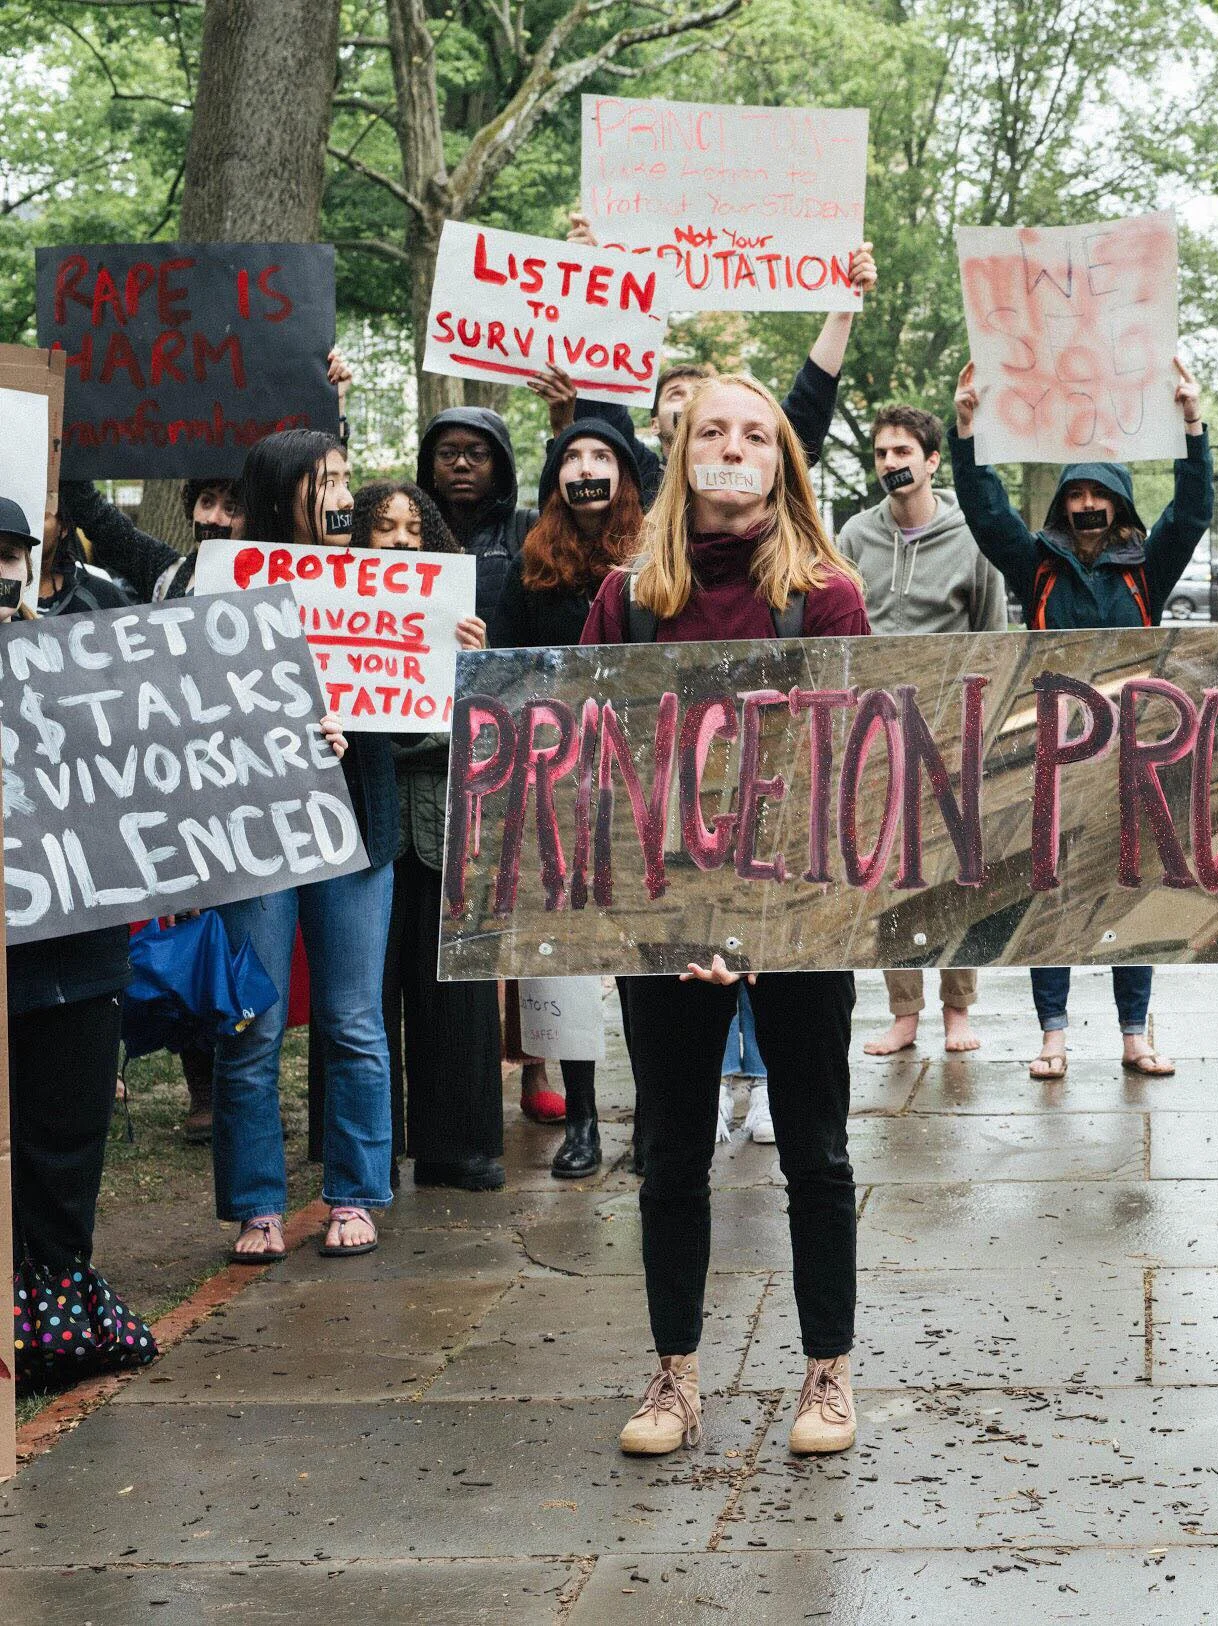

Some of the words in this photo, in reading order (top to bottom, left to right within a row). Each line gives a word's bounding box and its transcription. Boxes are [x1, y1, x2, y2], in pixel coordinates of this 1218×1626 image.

[474, 233, 656, 313] LISTEN
[722, 228, 774, 248] Your
[54, 254, 197, 328] RAPE
[237, 265, 294, 323] IS
[527, 300, 560, 322] TO
[432, 311, 655, 381] SURVIVORS
[706, 471, 753, 487] LISTEN
[234, 547, 442, 597] PROTECT
[0, 598, 301, 681] NCETON
[347, 654, 425, 684] YOUR
[446, 673, 991, 918] PRINCETON
[4, 790, 357, 926] SILENCED
